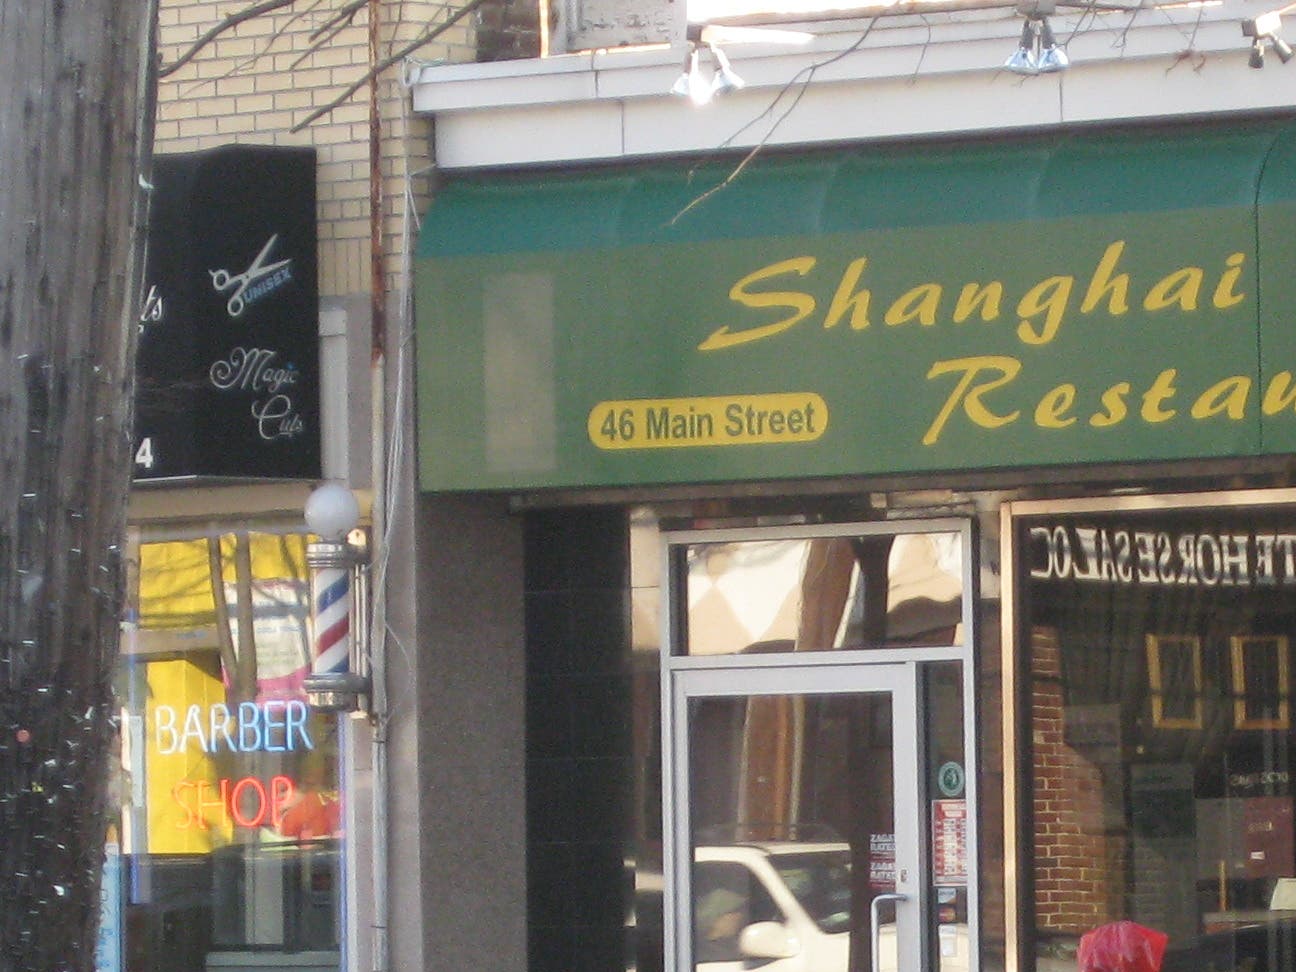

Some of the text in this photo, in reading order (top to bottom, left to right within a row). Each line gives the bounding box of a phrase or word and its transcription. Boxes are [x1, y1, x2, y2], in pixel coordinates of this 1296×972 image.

[244, 267, 292, 302] UNISEX
[698, 239, 1247, 352] Shanghai
[209, 346, 299, 393] Magic
[251, 394, 304, 440] Cuts
[599, 398, 817, 443] 46 Main Street
[155, 701, 312, 753] BARBER
[173, 776, 292, 829] SHOP
